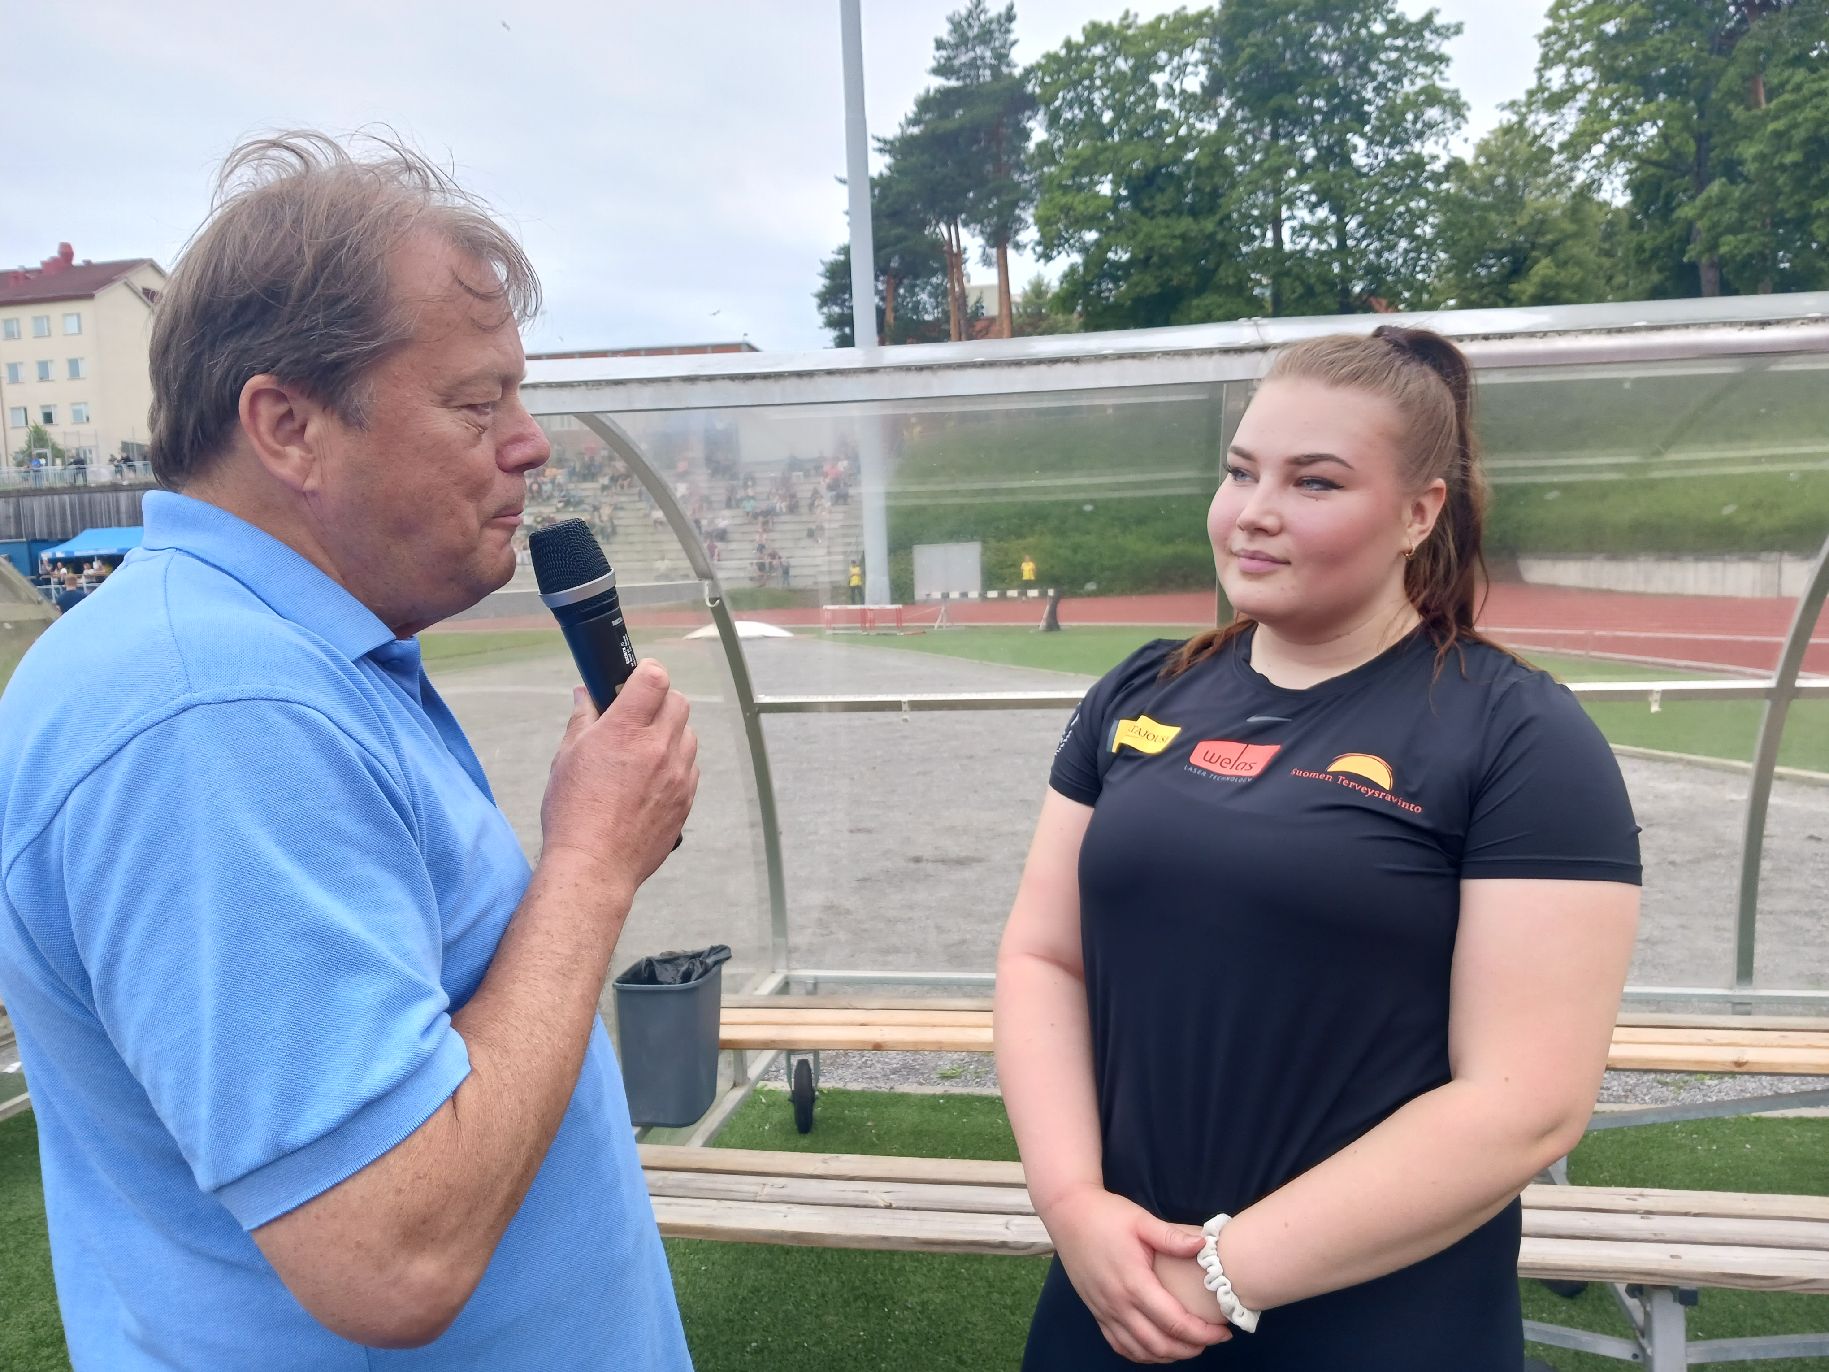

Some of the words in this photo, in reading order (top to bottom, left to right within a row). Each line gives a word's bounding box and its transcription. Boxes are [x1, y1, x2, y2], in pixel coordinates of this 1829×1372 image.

[1203, 744, 1257, 771] welas
[1183, 764, 1207, 778] LASER
[1209, 773, 1253, 784] TECHNOLOGY
[1336, 775, 1423, 814] Terveysravinto
